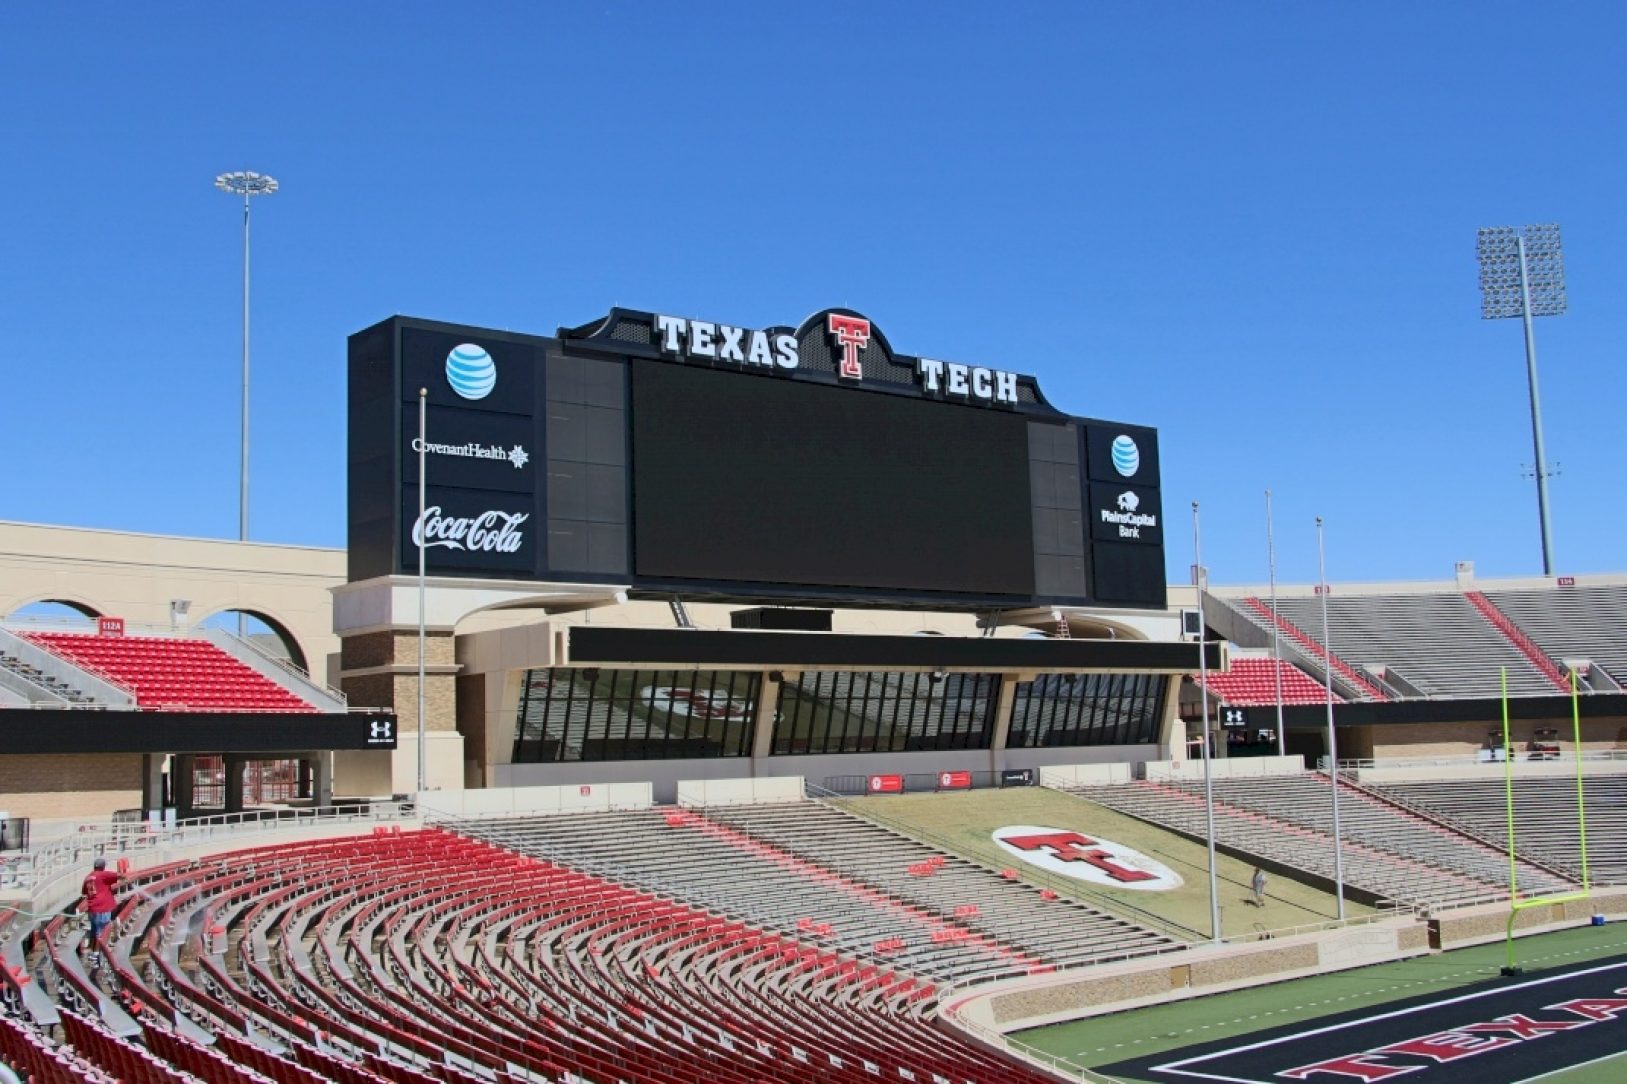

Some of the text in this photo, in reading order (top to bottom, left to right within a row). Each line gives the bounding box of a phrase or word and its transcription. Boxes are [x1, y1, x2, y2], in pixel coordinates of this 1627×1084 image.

[657, 315, 799, 369] TEXAS
[920, 358, 1018, 402] TECH
[411, 505, 530, 553] Coca-Cola
[1101, 509, 1157, 527] PlainsCapital
[1118, 524, 1140, 539] Bank
[1273, 986, 1627, 1083] TEXA
